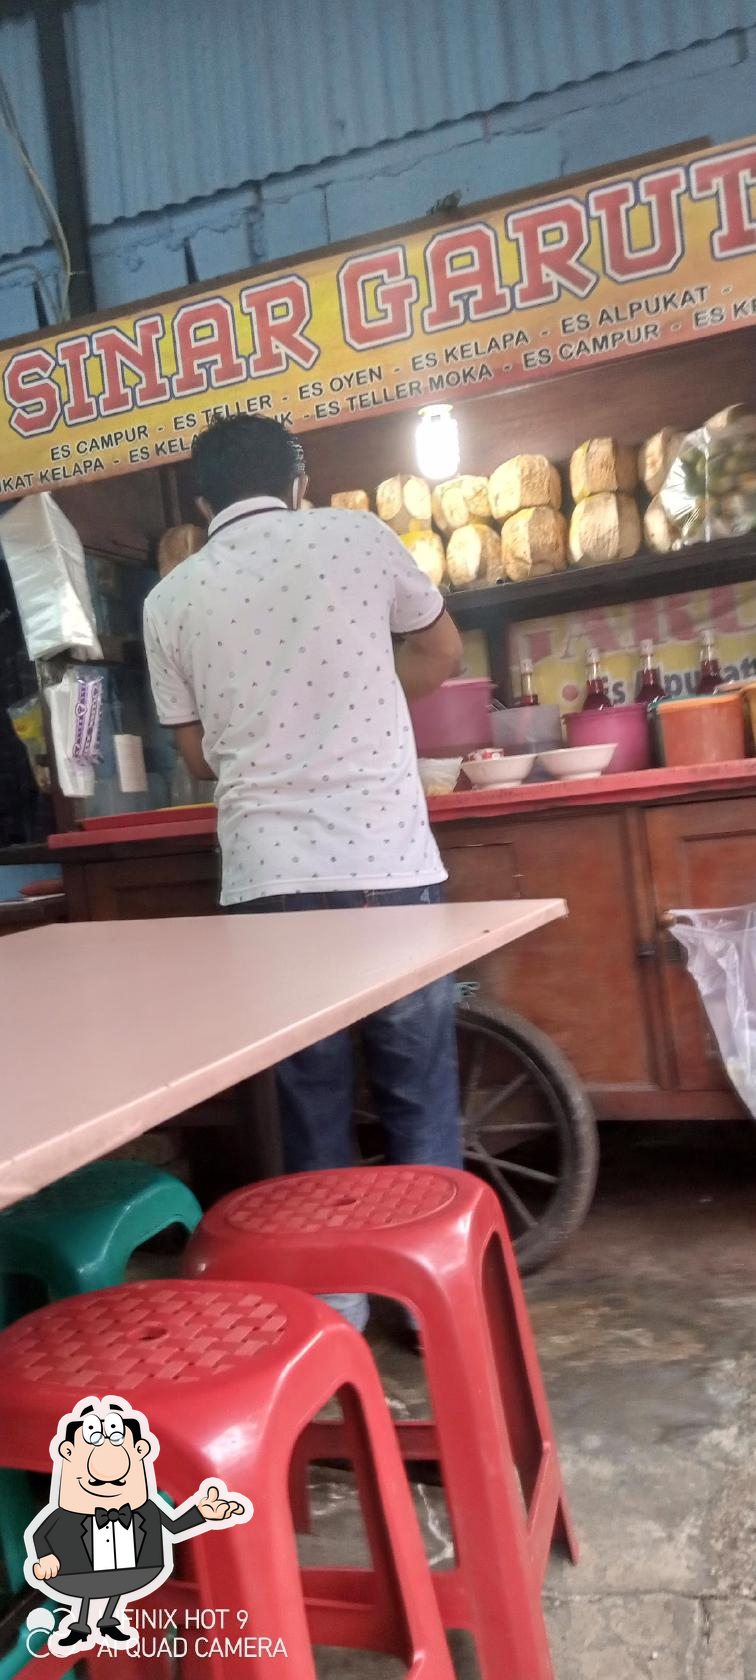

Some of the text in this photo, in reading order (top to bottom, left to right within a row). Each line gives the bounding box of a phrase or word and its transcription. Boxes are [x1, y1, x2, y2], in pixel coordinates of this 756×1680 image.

[4, 145, 756, 438] SINAR GARUT
[51, 445, 71, 461] ES
[76, 425, 149, 455] CAMPUR
[174, 413, 197, 430] ES
[299, 382, 323, 400] ES
[330, 366, 382, 392] OYEN
[412, 352, 437, 371] ES
[444, 330, 529, 363] KELAPA
[562, 314, 590, 334] ES
[599, 286, 708, 326] ALPUKAT
[0, 473, 34, 492] KAT
[40, 457, 104, 483] KELAPA
[129, 446, 150, 463] ES
[155, 434, 199, 457] KELA
[315, 400, 340, 419] ES
[346, 380, 422, 411] TELLER
[429, 363, 493, 391] MOKA
[524, 348, 551, 369] ES
[560, 324, 659, 360] CAMPUR
[694, 306, 724, 327] ES
